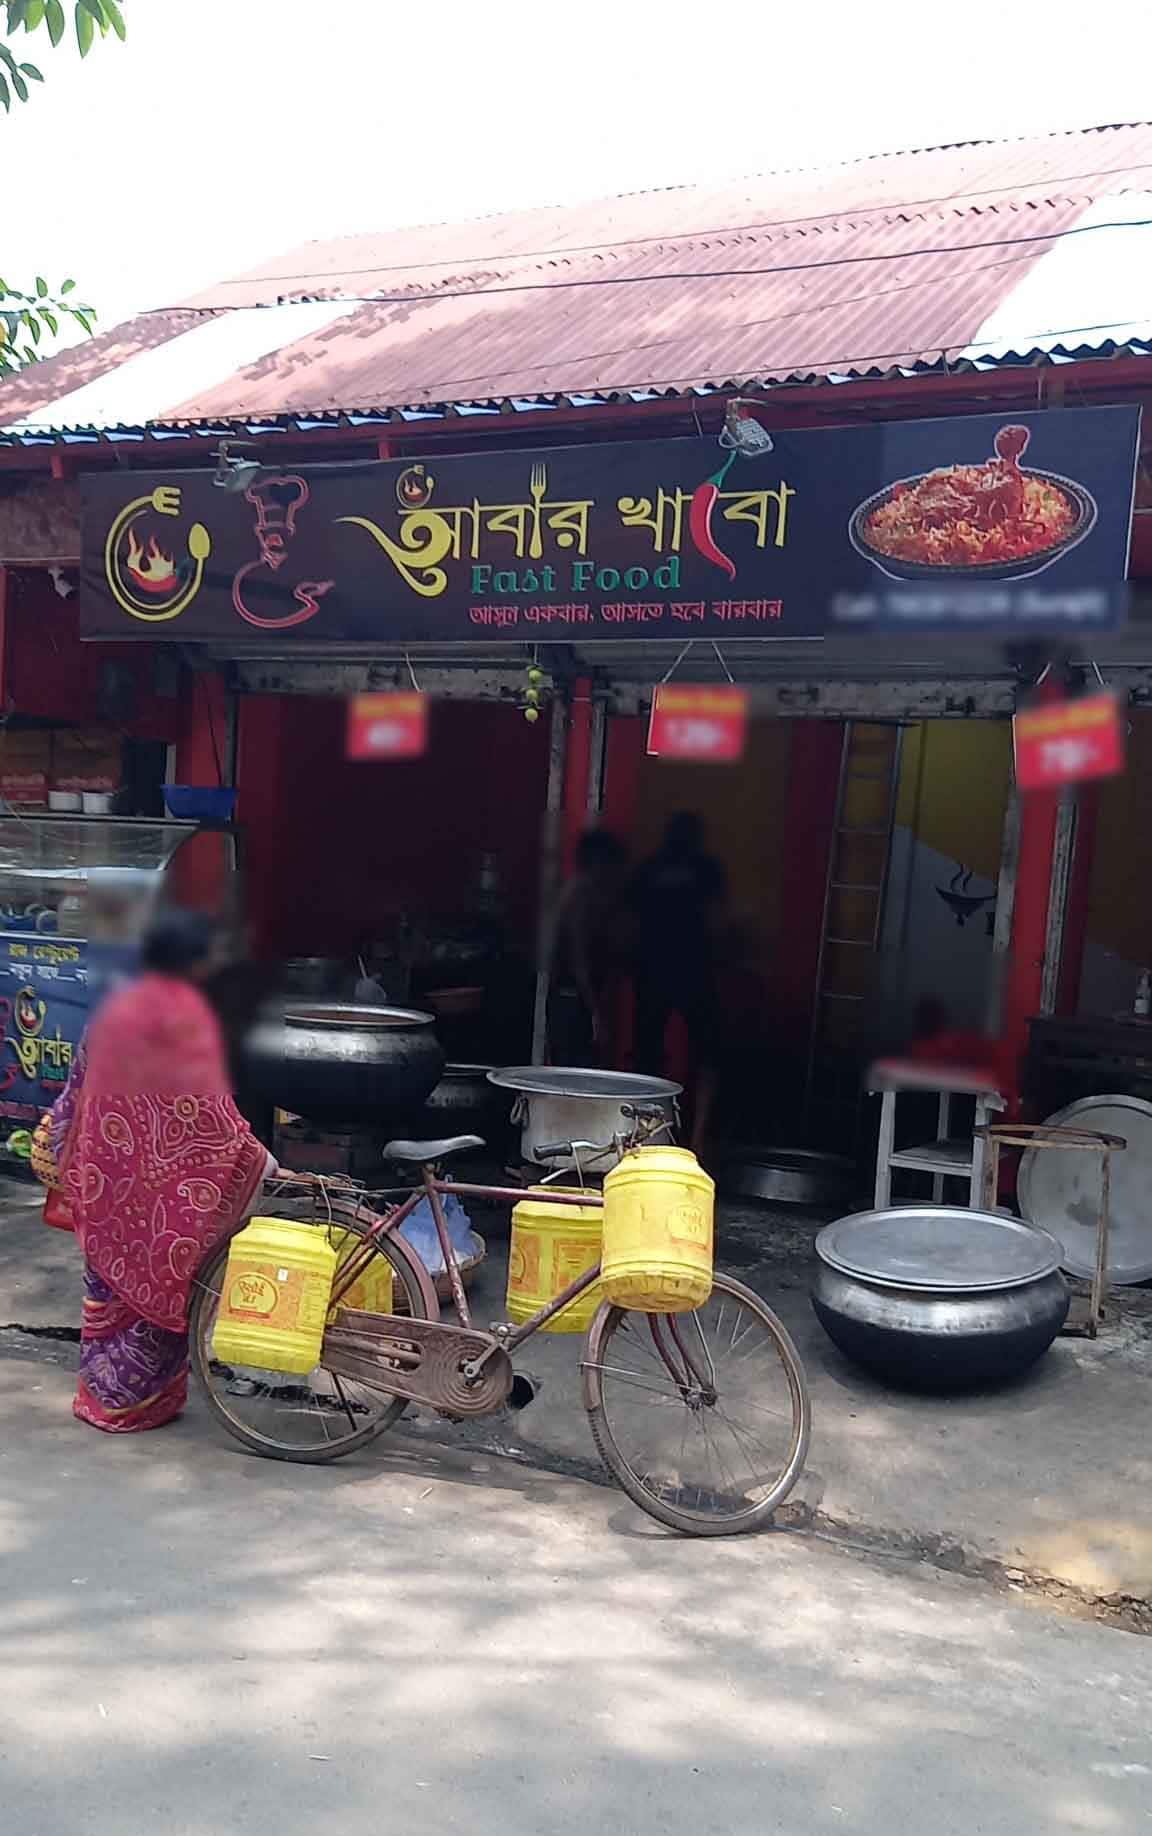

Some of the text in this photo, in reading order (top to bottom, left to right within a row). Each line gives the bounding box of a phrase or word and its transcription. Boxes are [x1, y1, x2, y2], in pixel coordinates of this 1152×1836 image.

[335, 456, 797, 597] আবার খাবো
[471, 556, 682, 595] Fast Food
[468, 605, 519, 628] আসুন
[600, 602, 665, 624] আসতে
[671, 601, 705, 622] হবে
[711, 599, 784, 620] বারবার
